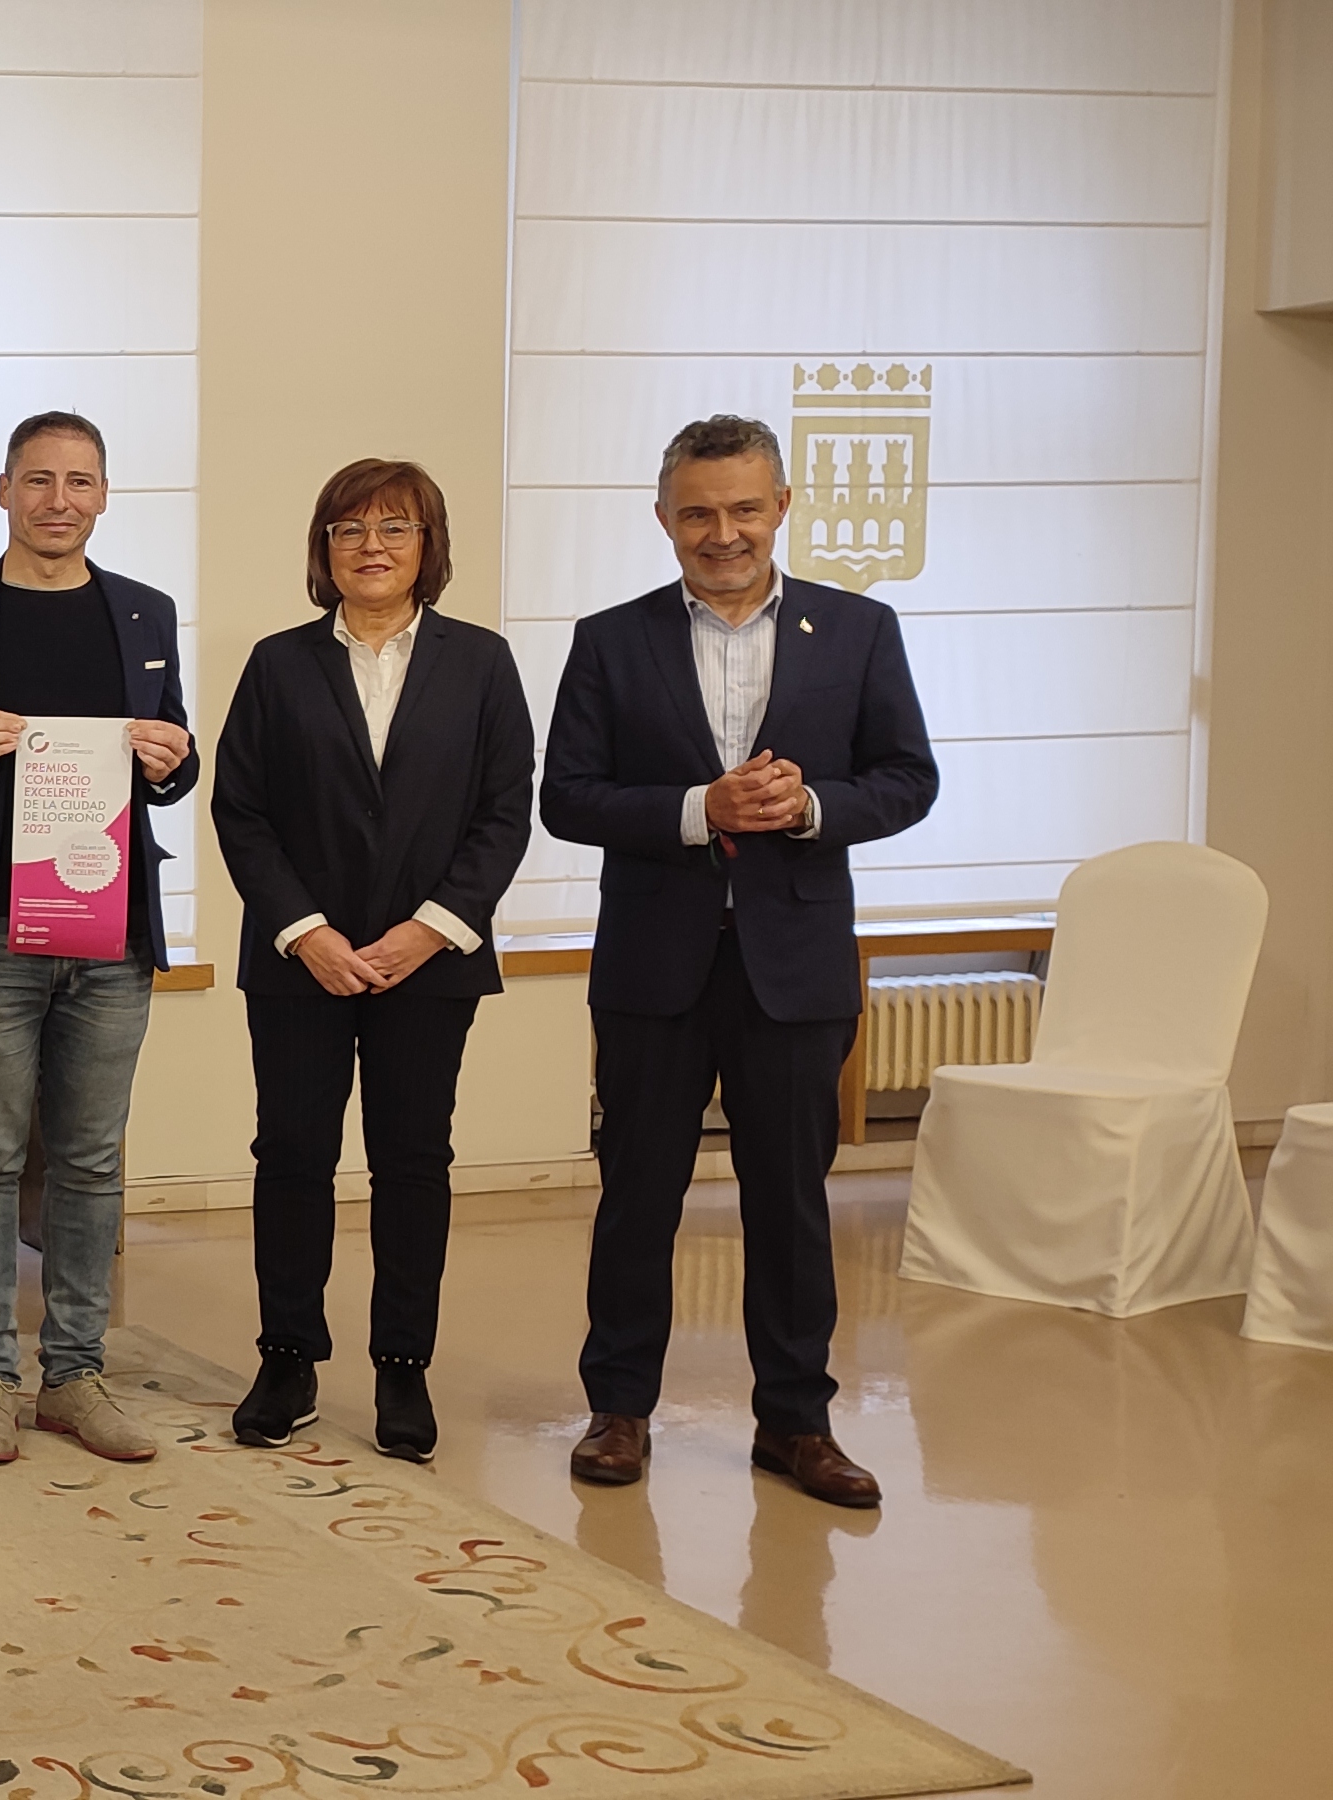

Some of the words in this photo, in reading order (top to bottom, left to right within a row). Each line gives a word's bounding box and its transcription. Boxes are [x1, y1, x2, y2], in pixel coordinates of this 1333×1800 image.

[26, 763, 77, 773] PREMIOS
[24, 800, 38, 809] DE
[43, 800, 56, 809] LA
[61, 801, 106, 810] CIUDAD
[23, 812, 37, 821] DE
[43, 811, 105, 822] LOGROÑO
[22, 824, 50, 833] 2023
